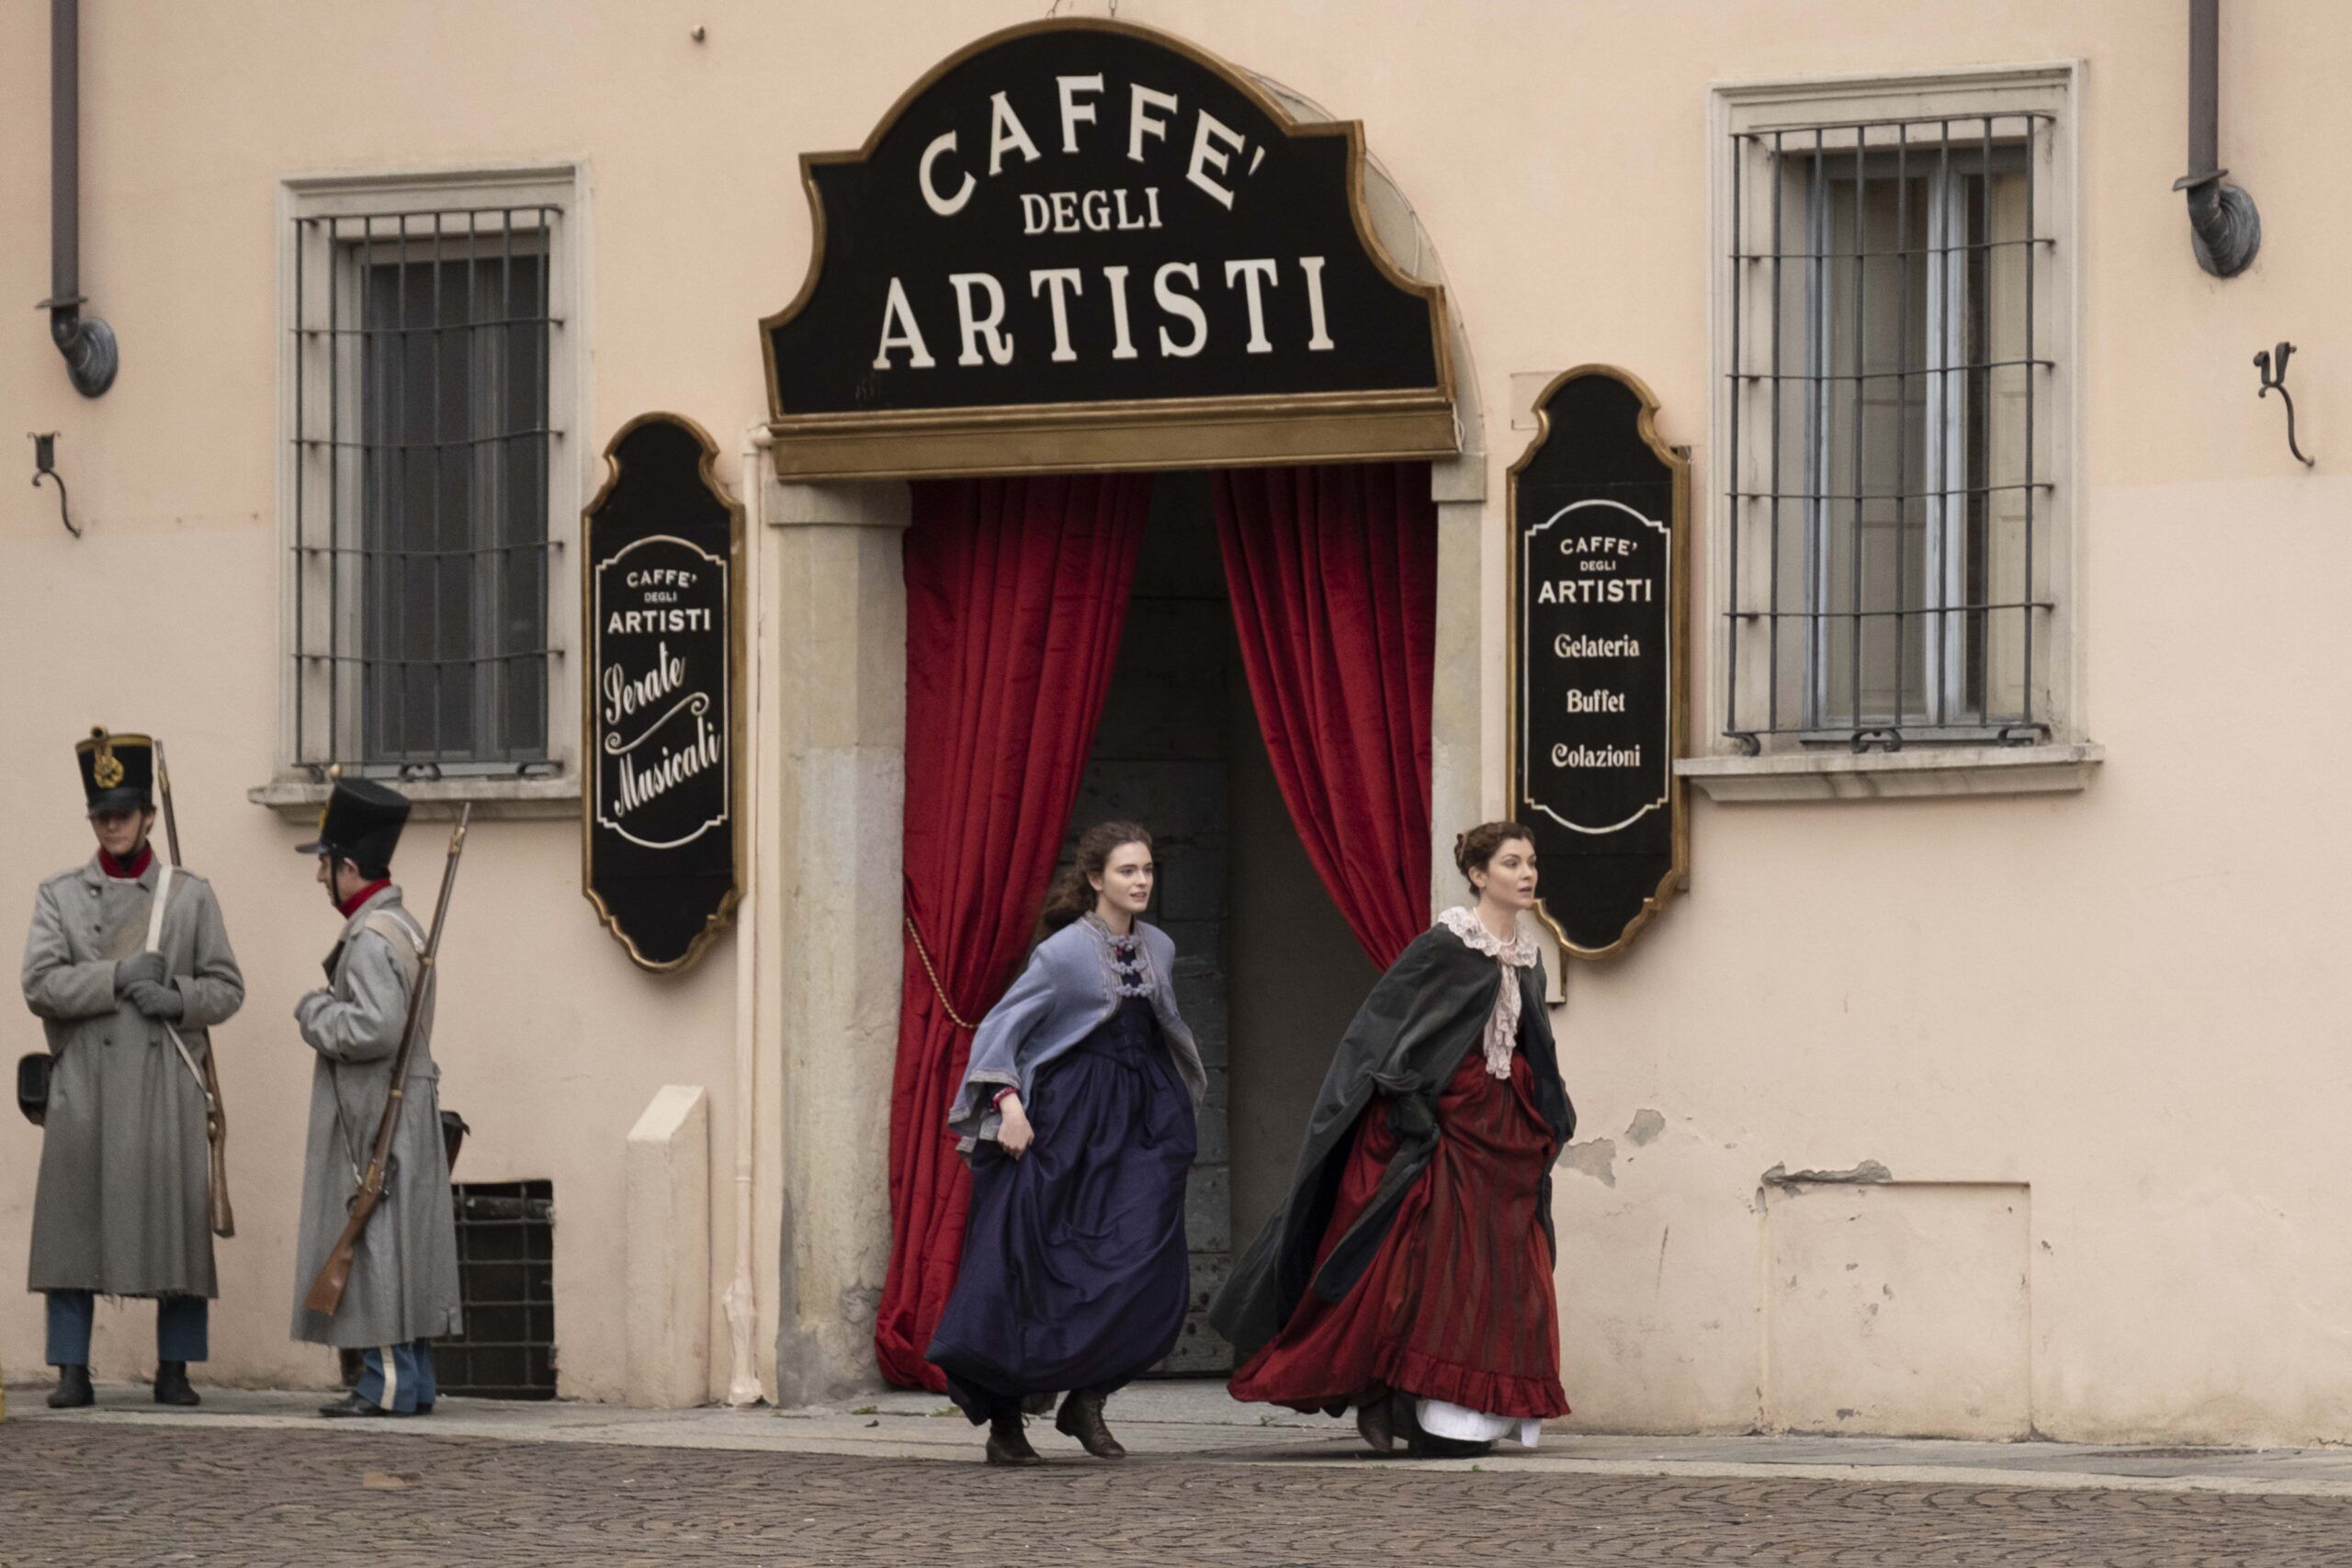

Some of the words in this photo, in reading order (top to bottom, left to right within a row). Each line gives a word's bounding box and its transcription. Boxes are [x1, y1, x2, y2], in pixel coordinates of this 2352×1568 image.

[919, 72, 1266, 217] CAFFE'
[1020, 186, 1163, 235] DEGLI
[872, 255, 1335, 370] ARTISTI
[1560, 536, 1638, 556] CAFFE'
[1579, 559, 1617, 571] DEGLI
[627, 569, 698, 588] CAFFE'
[1537, 578, 1653, 604] ARTISTI
[644, 592, 678, 603] DEGLI
[607, 608, 712, 634] ARTISTI
[1554, 633, 1641, 659] Gelateria
[604, 641, 686, 726] Serate
[1566, 688, 1626, 714] Buffet
[614, 715, 721, 818] Musicali
[1551, 742, 1642, 768] Colazioni
